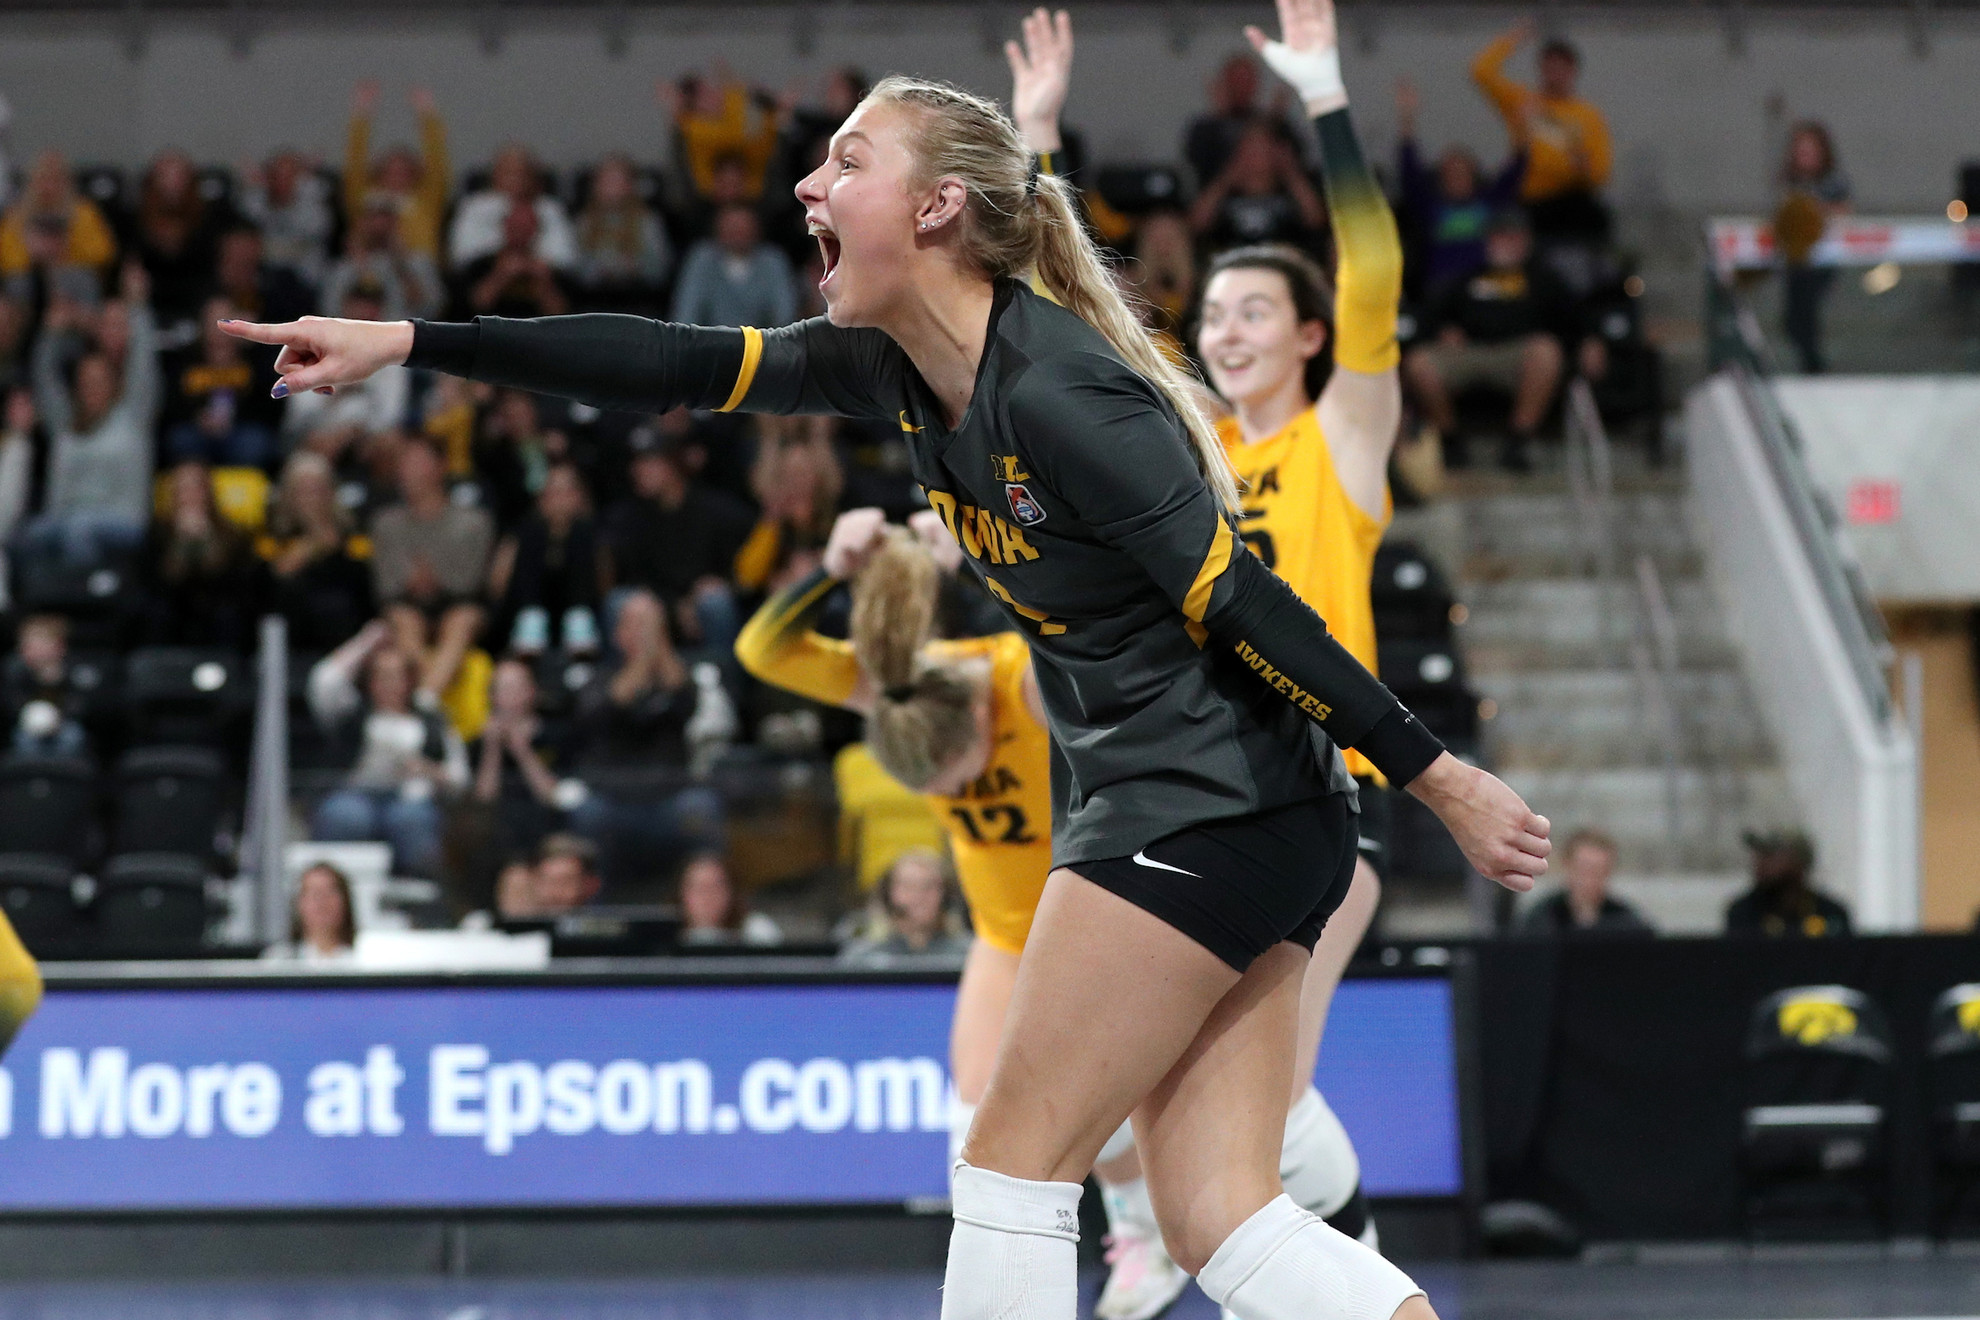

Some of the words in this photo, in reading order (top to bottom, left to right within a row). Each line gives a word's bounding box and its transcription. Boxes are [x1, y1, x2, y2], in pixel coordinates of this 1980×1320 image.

[918, 483, 1040, 565] OWA
[950, 803, 1038, 845] 12
[39, 1046, 281, 1139] More
[304, 1044, 406, 1137] at
